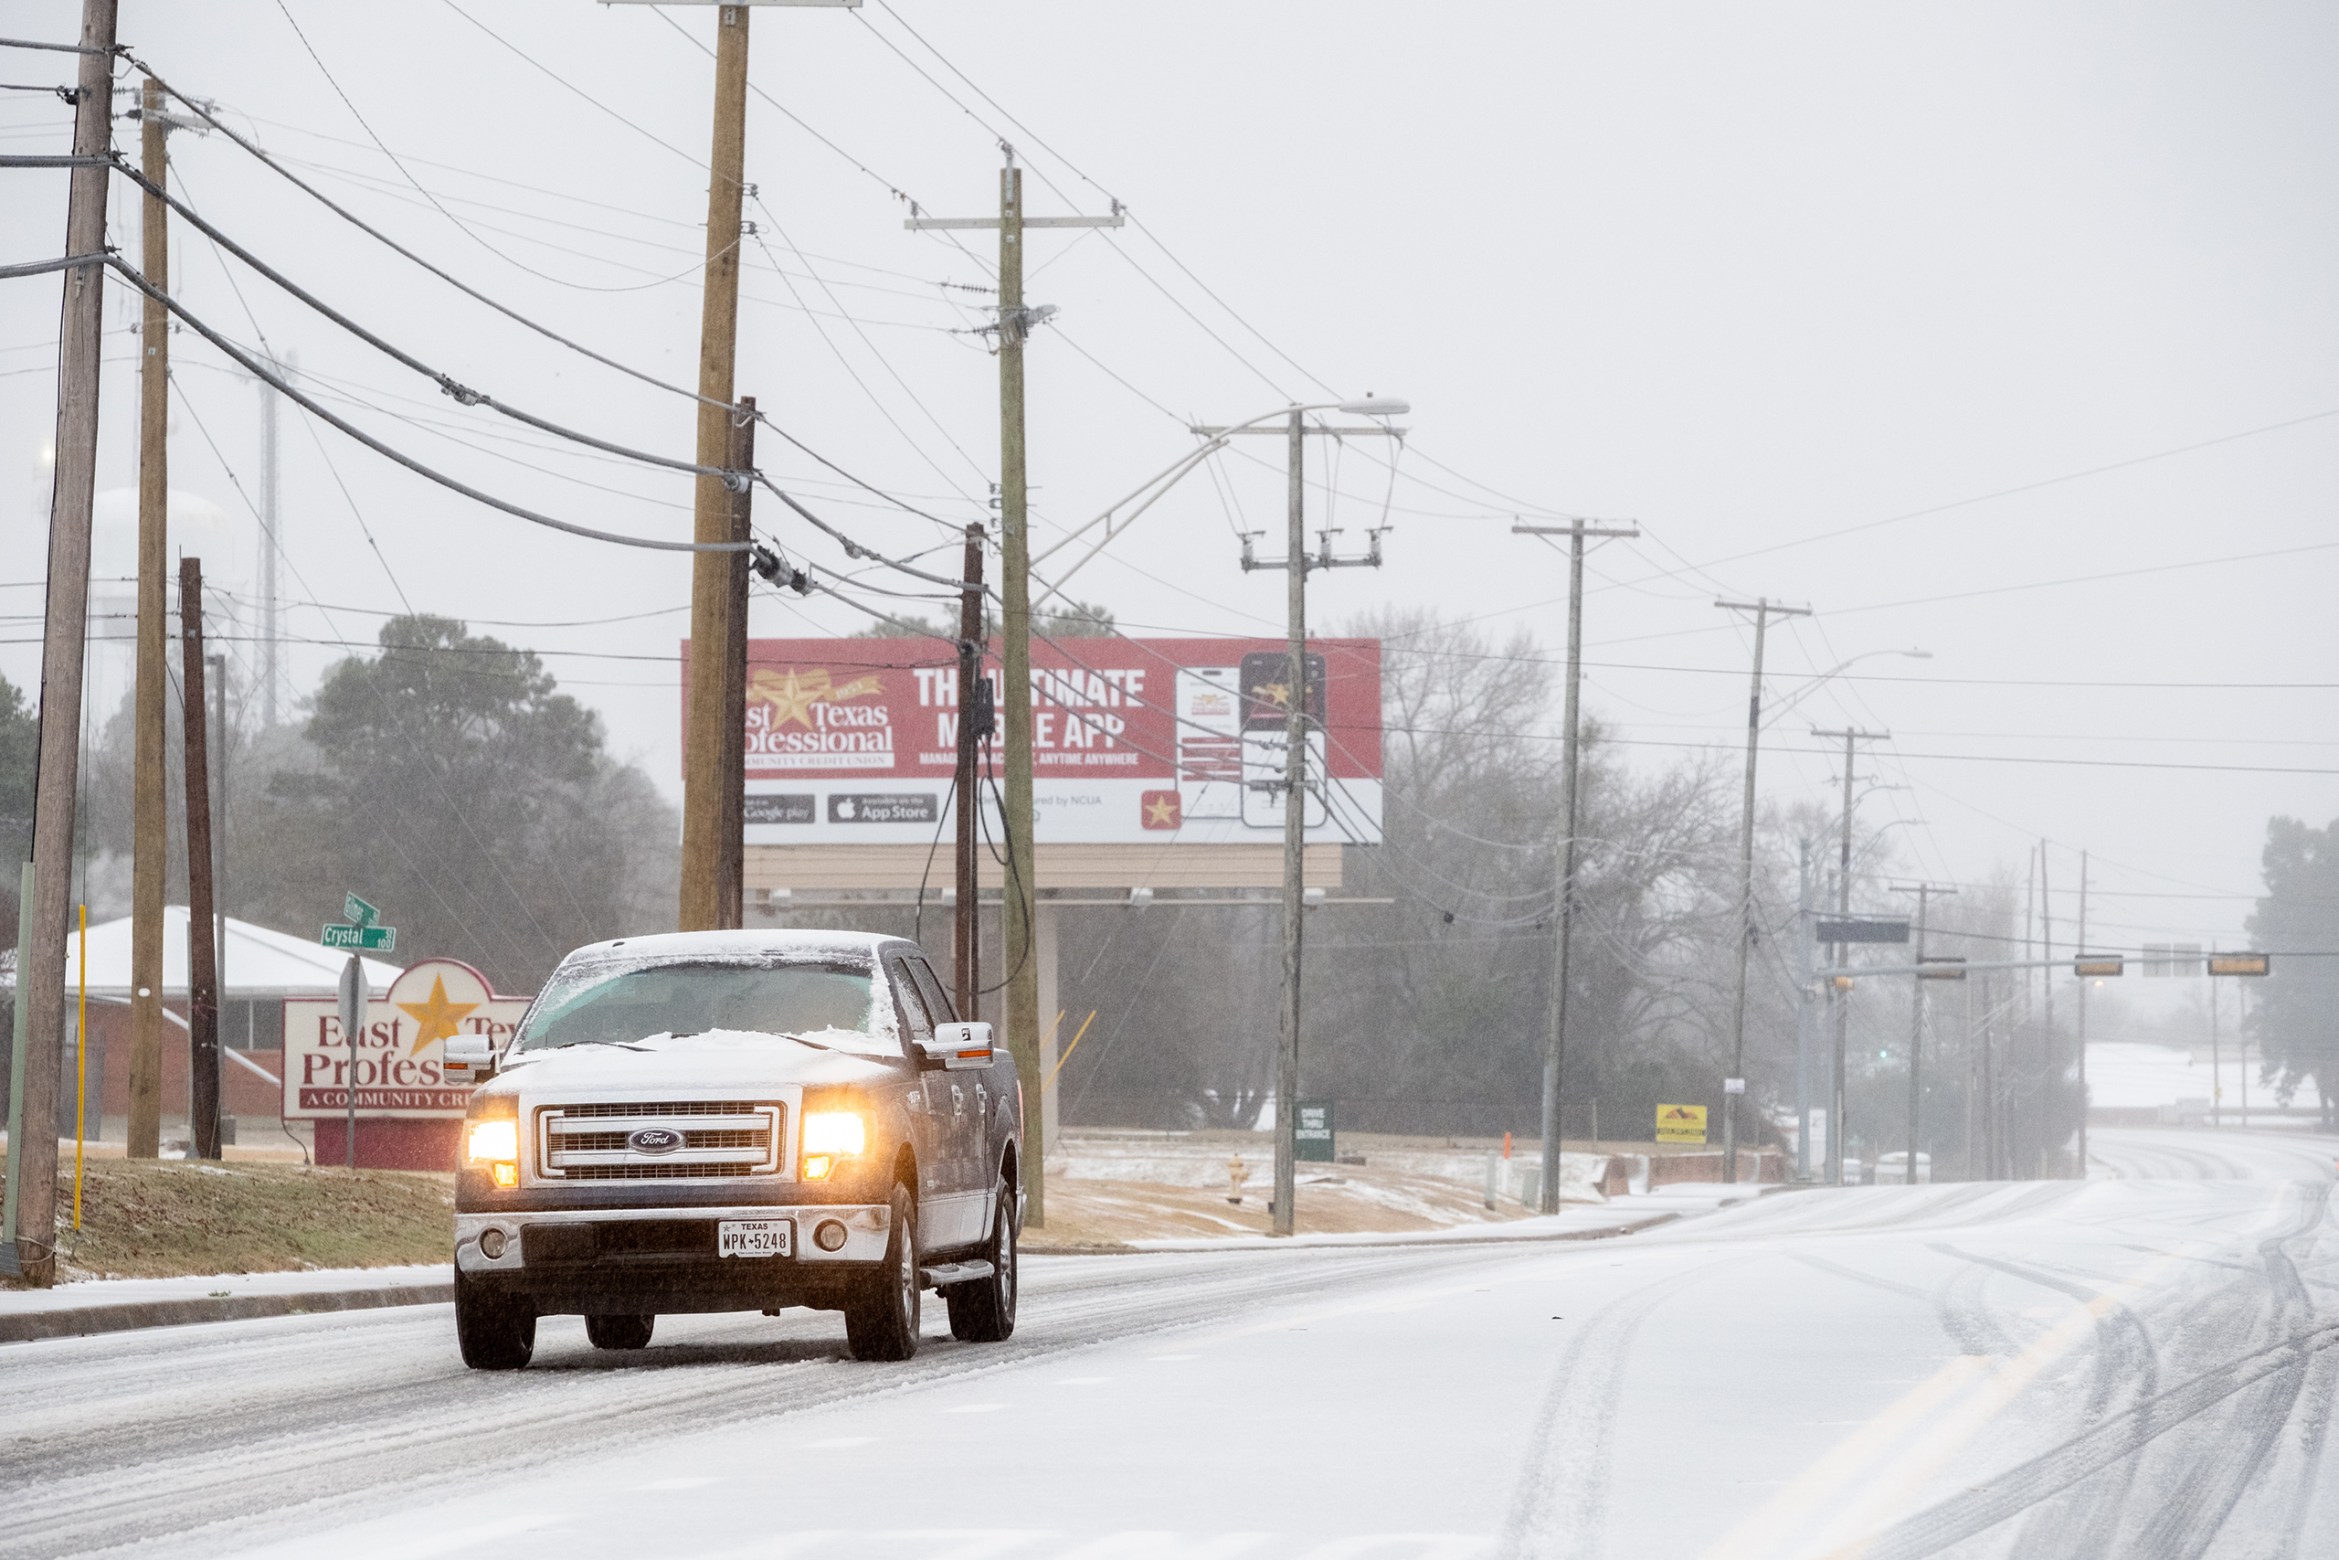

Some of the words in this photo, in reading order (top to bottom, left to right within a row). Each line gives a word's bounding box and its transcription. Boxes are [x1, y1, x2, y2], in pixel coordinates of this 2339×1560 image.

[913, 669, 957, 706] TH
[987, 669, 1145, 707] UTIMATE
[810, 703, 888, 727] Texas
[937, 712, 1055, 748] MBE
[1063, 713, 1125, 748] APP
[745, 727, 893, 752] ofessional
[747, 757, 796, 766] MUNITY
[800, 756, 844, 765] CREDIT
[848, 756, 885, 765] UNION
[920, 752, 957, 765] MANAG
[1039, 753, 1082, 765] ANYTIME
[1085, 753, 1138, 766] ANYWHERE
[1070, 796, 1101, 805] NCUA
[862, 806, 890, 820] App
[892, 805, 929, 818] Store
[325, 926, 363, 947] Crystal
[378, 938, 391, 948] 100
[302, 1050, 462, 1087] Profes
[306, 1092, 319, 1106] A
[1301, 1108, 1325, 1119] DRIVE
[640, 1132, 669, 1145] Ford
[1296, 1129, 1331, 1139] ENTRANCE
[741, 1223, 768, 1231] TEXAS
